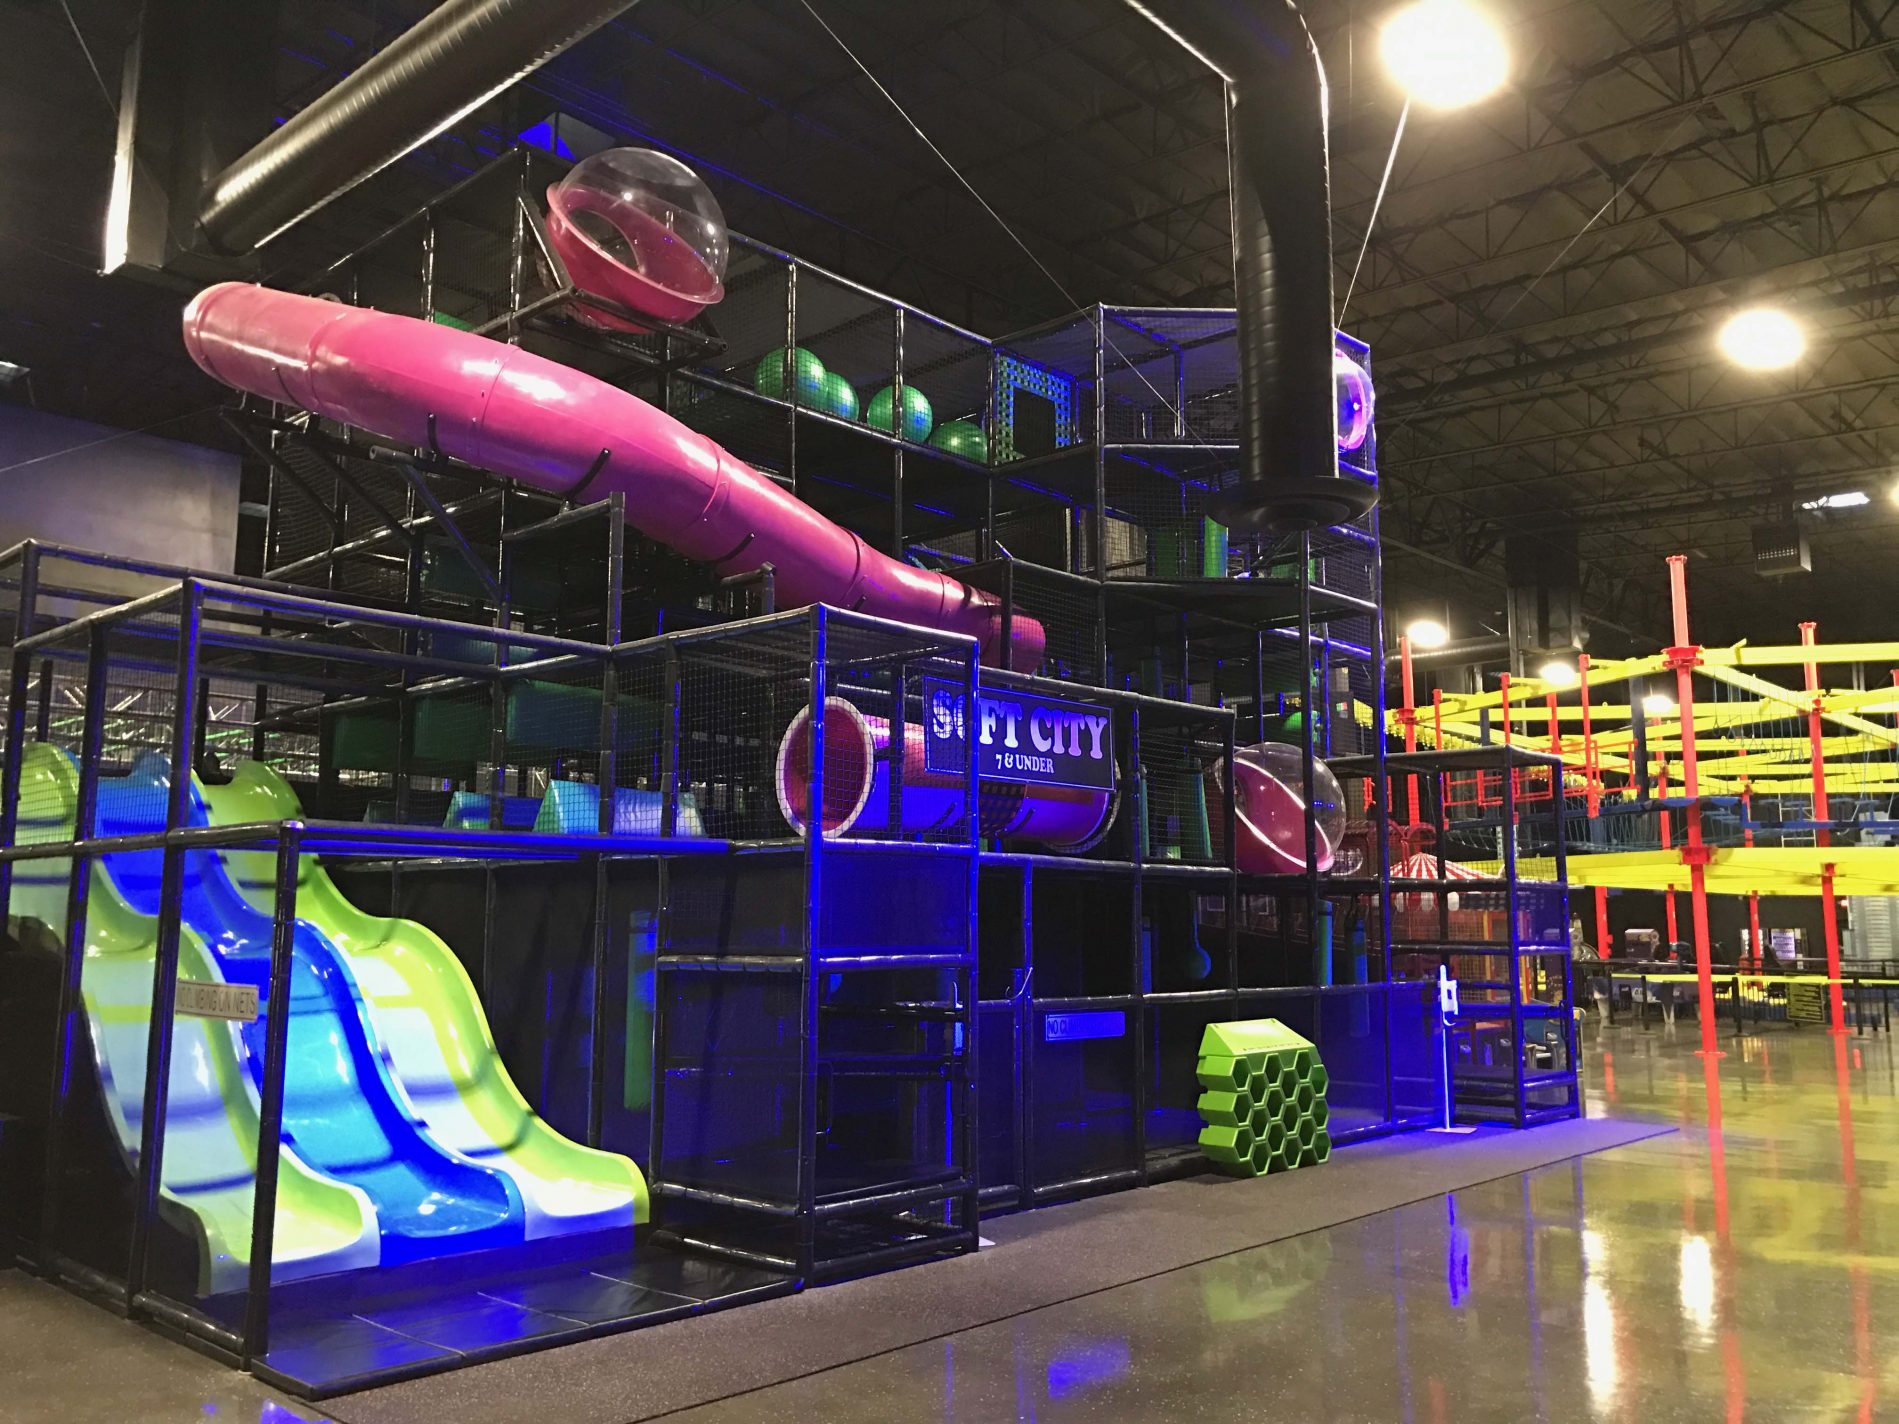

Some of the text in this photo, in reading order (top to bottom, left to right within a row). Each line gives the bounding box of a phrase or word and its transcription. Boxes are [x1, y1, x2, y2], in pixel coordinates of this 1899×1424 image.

[1030, 706, 1108, 759] CITY
[996, 752, 1055, 774] 7 & UNDER
[233, 991, 256, 1014] NETS
[1048, 1019, 1059, 1034] NO
